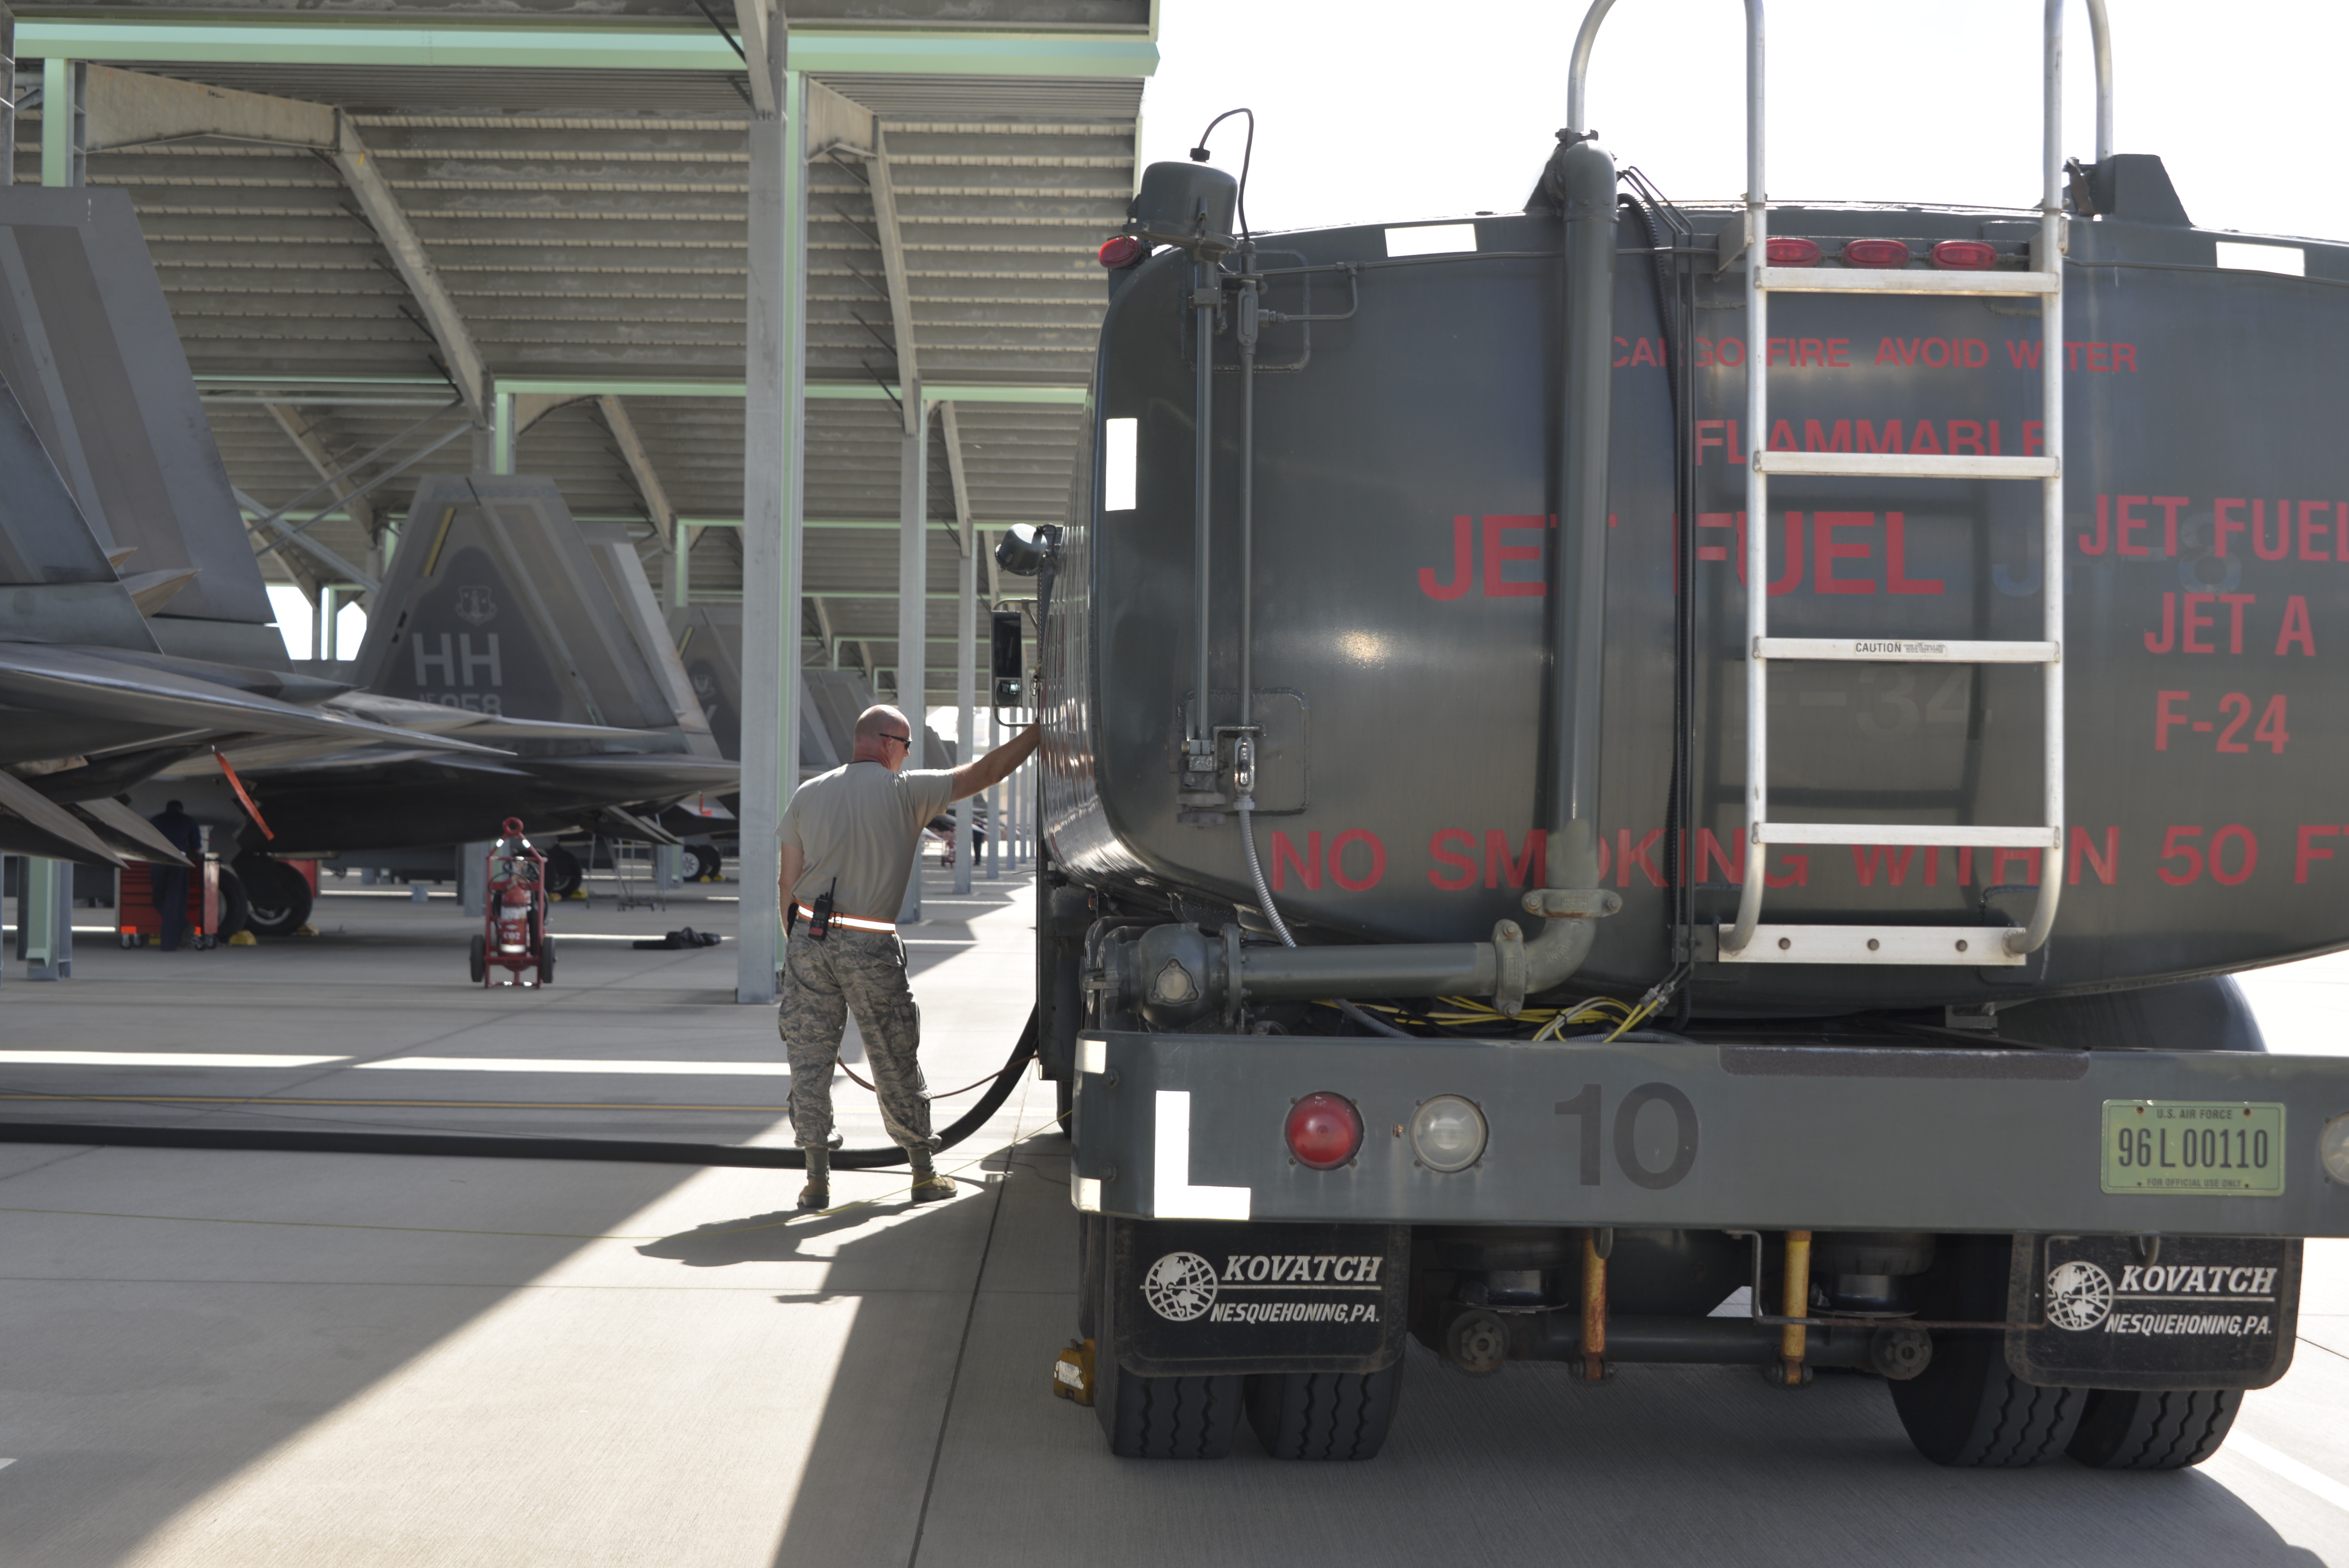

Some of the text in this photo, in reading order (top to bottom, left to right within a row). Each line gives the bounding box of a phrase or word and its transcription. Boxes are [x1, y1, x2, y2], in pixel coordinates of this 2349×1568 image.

[1766, 338, 1850, 367] FIRE
[1874, 337, 1989, 368] AVOID
[2006, 340, 2138, 372] WTER
[2078, 495, 2190, 556] JET
[1418, 513, 1617, 601] JE
[1855, 642, 1901, 652] CAUTION
[2144, 592, 2316, 656] JET A
[412, 633, 503, 686] HH
[2155, 690, 2289, 754] F-24
[1271, 824, 2349, 892] NO SMKING WIHN 50 F
[1554, 1082, 1699, 1190] 10
[2157, 1108, 2232, 1120] U.S. AIR FORCE
[2147, 1178, 2242, 1188] FOR OFFICIAL USE ONLY
[1221, 1255, 1383, 1281] KOVATCH
[2116, 1265, 2278, 1293] KOVATCH
